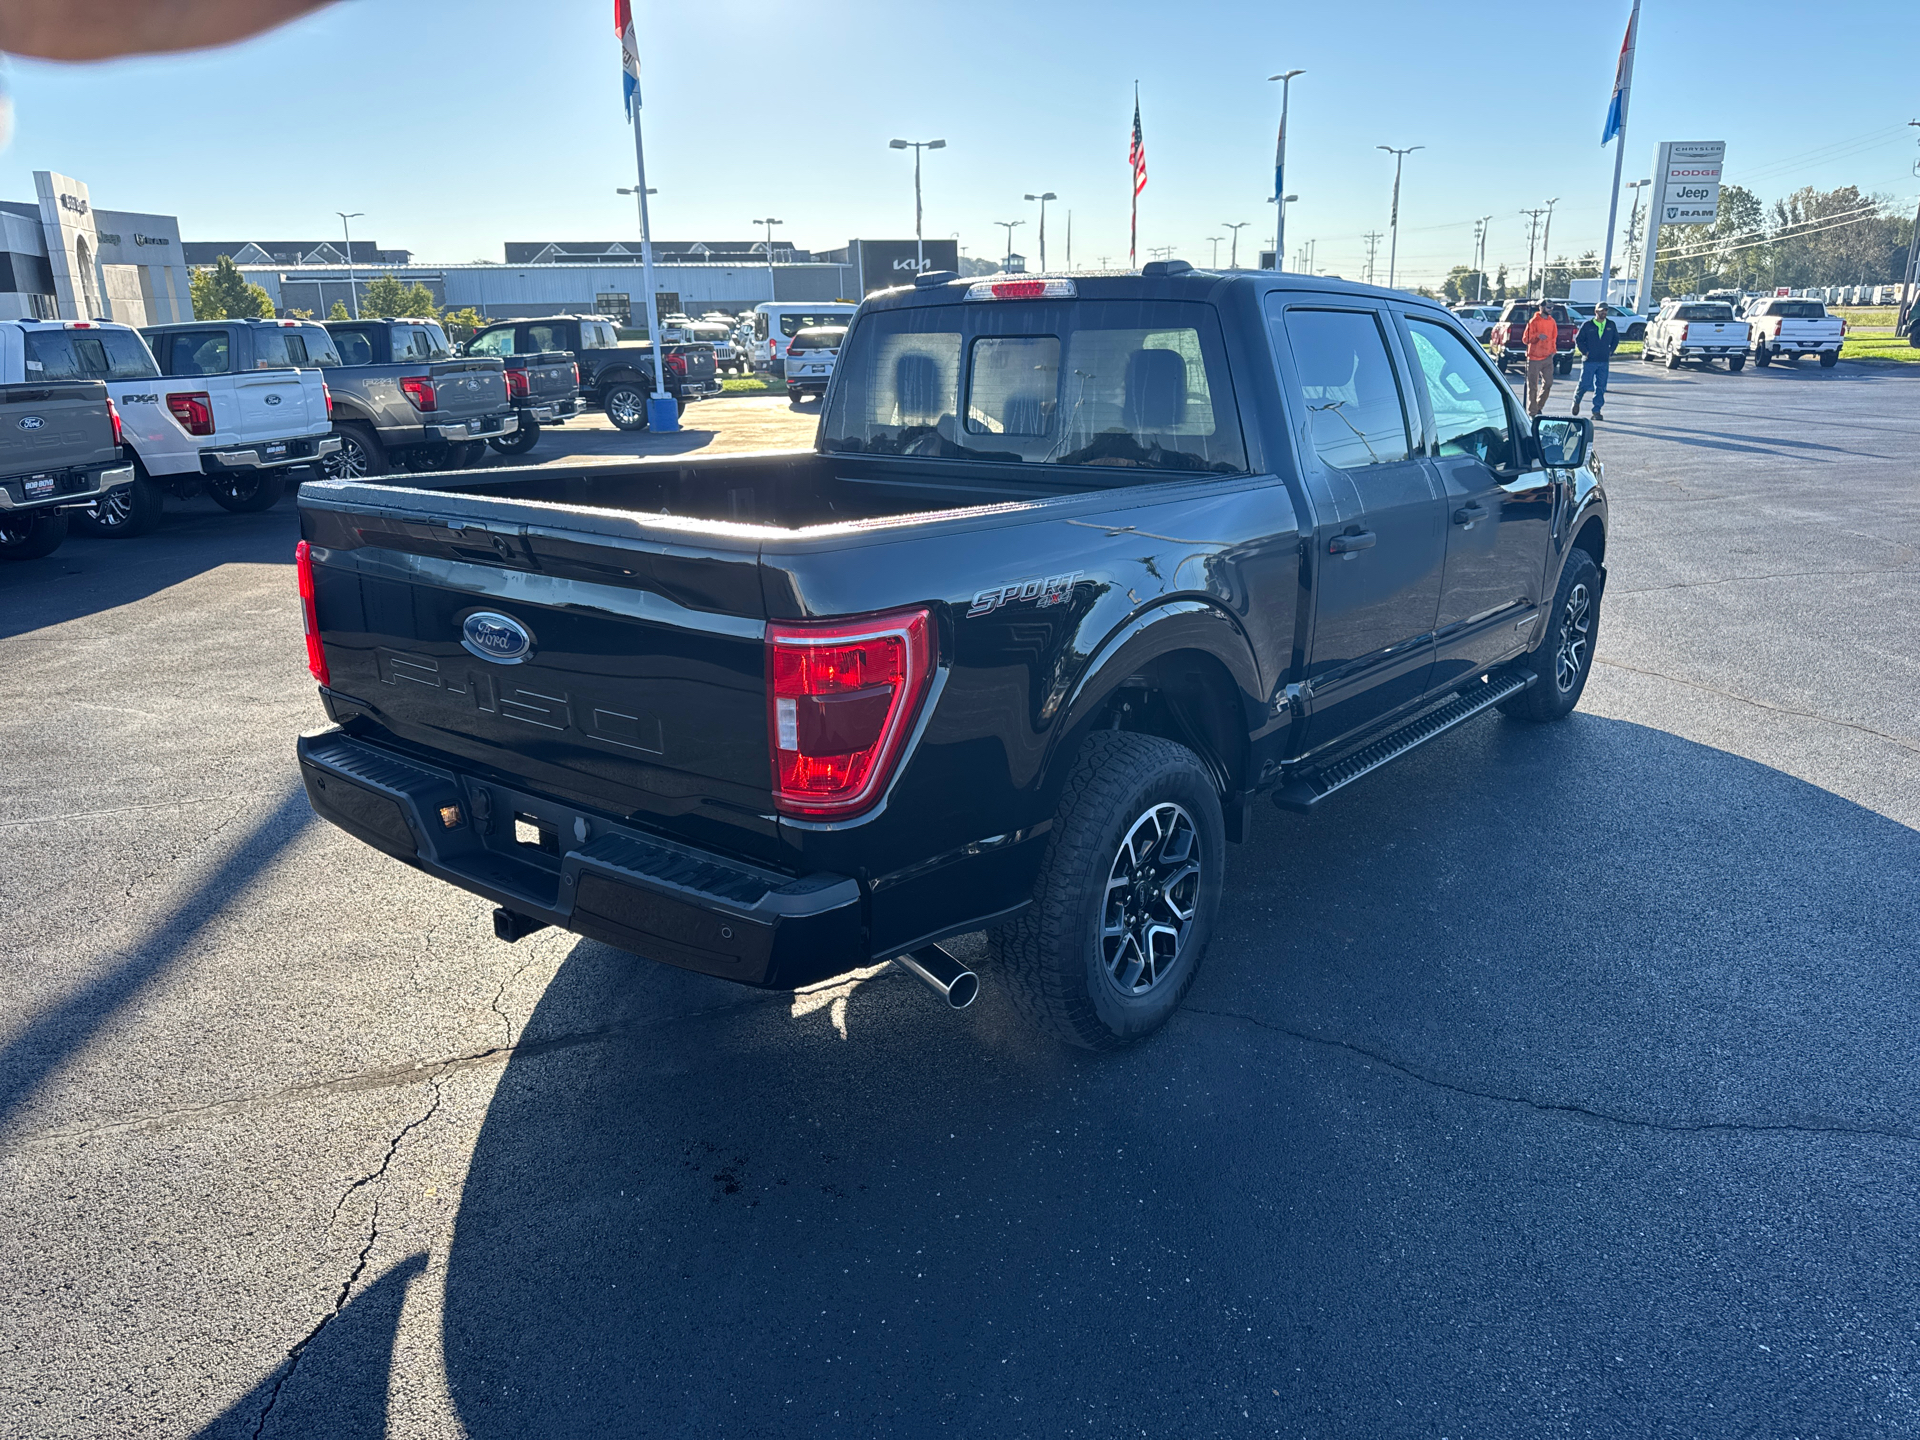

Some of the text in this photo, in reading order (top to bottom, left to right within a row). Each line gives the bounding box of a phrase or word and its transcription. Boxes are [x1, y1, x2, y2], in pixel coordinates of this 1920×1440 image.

[1671, 169, 1720, 177] DODGE
[1676, 186, 1709, 201] Jeep
[122, 394, 159, 405] FX4
[23, 417, 42, 428] Ford
[966, 570, 1085, 619] SPORT
[475, 621, 511, 649] Ford
[375, 646, 664, 755] F-150
